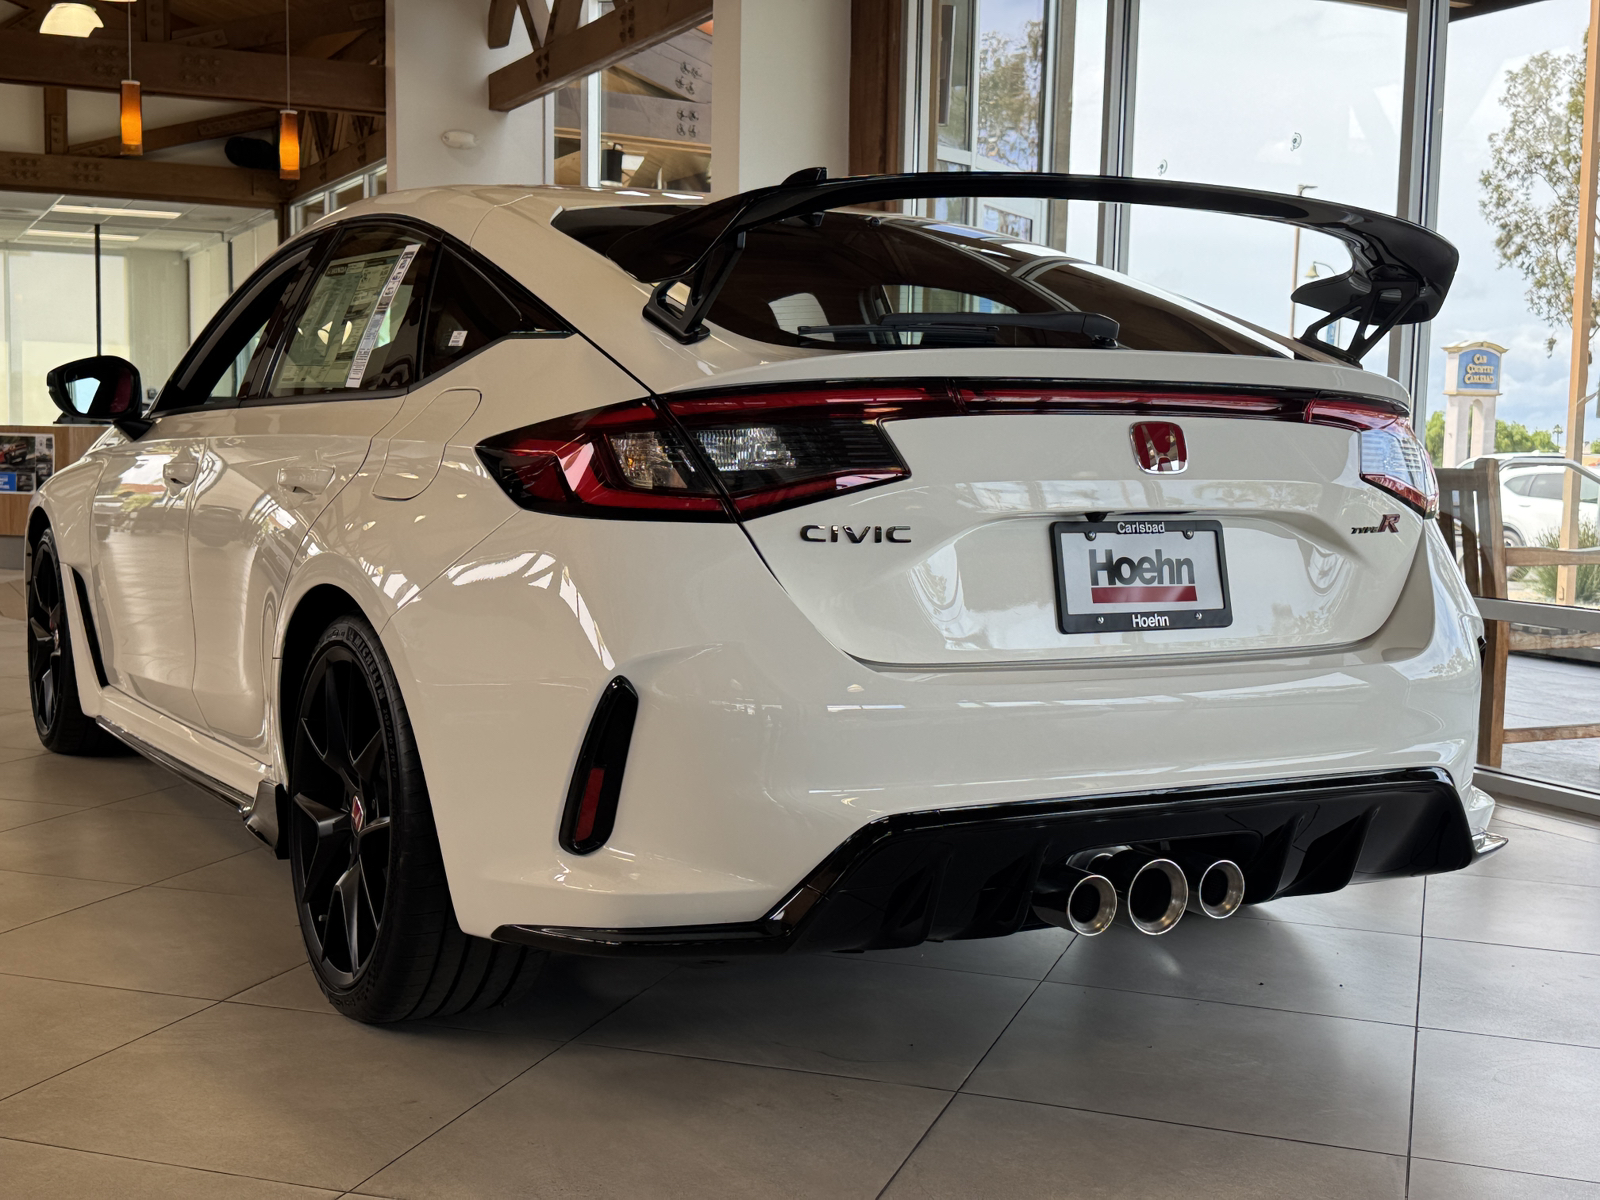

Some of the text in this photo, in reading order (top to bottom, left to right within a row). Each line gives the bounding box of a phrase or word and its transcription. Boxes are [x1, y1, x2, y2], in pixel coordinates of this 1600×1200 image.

[799, 525, 911, 543] CIVIC
[1117, 522, 1165, 534] Carlsbad
[1088, 549, 1195, 586] Hoehn
[1132, 613, 1170, 628] Hoehn
[353, 631, 386, 700] MICHELIN
